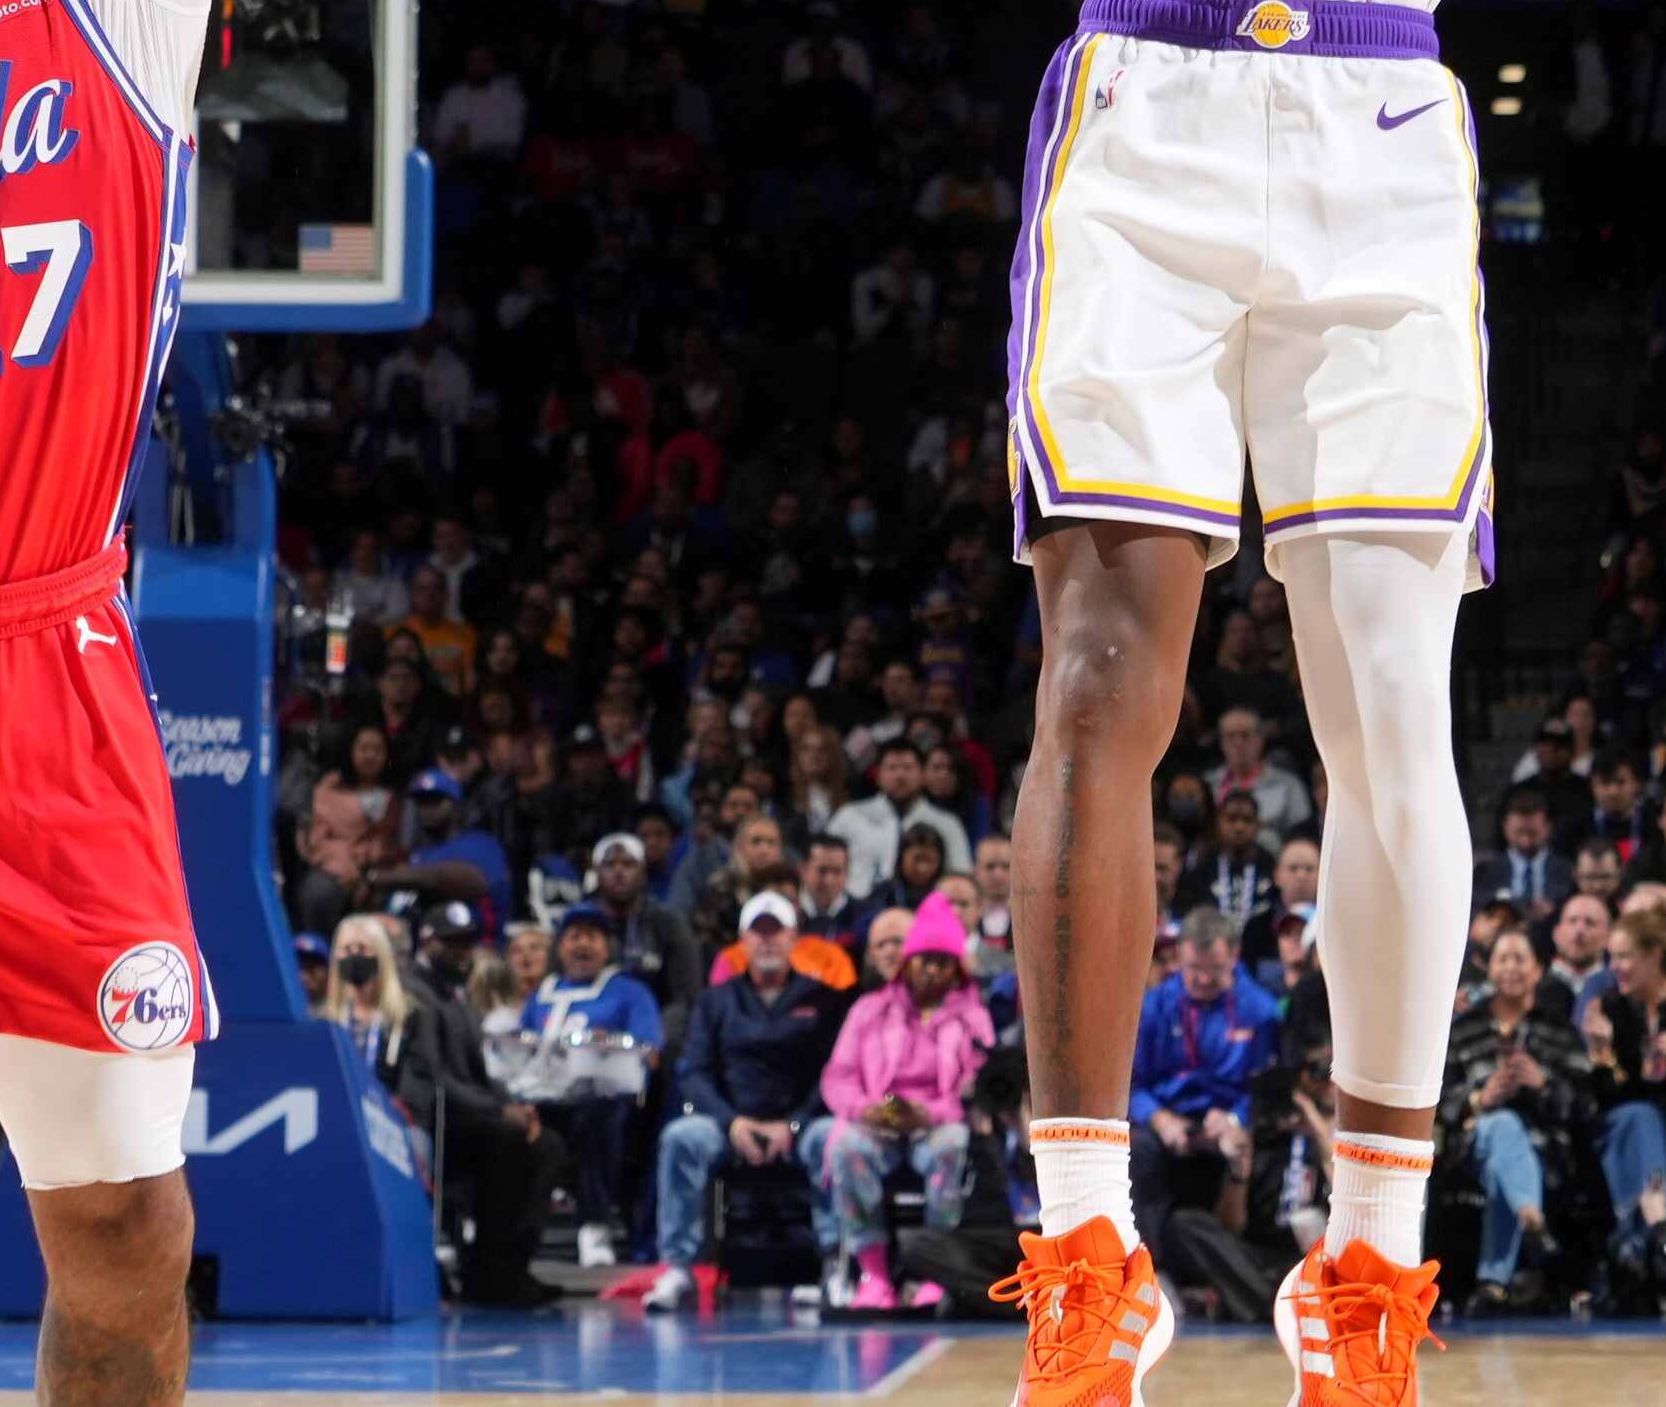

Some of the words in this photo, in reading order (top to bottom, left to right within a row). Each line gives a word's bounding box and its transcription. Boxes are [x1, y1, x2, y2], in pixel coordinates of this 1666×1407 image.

[1239, 11, 1309, 38] LAKERS
[168, 743, 250, 785] Giving
[111, 986, 186, 1024] 76ers
